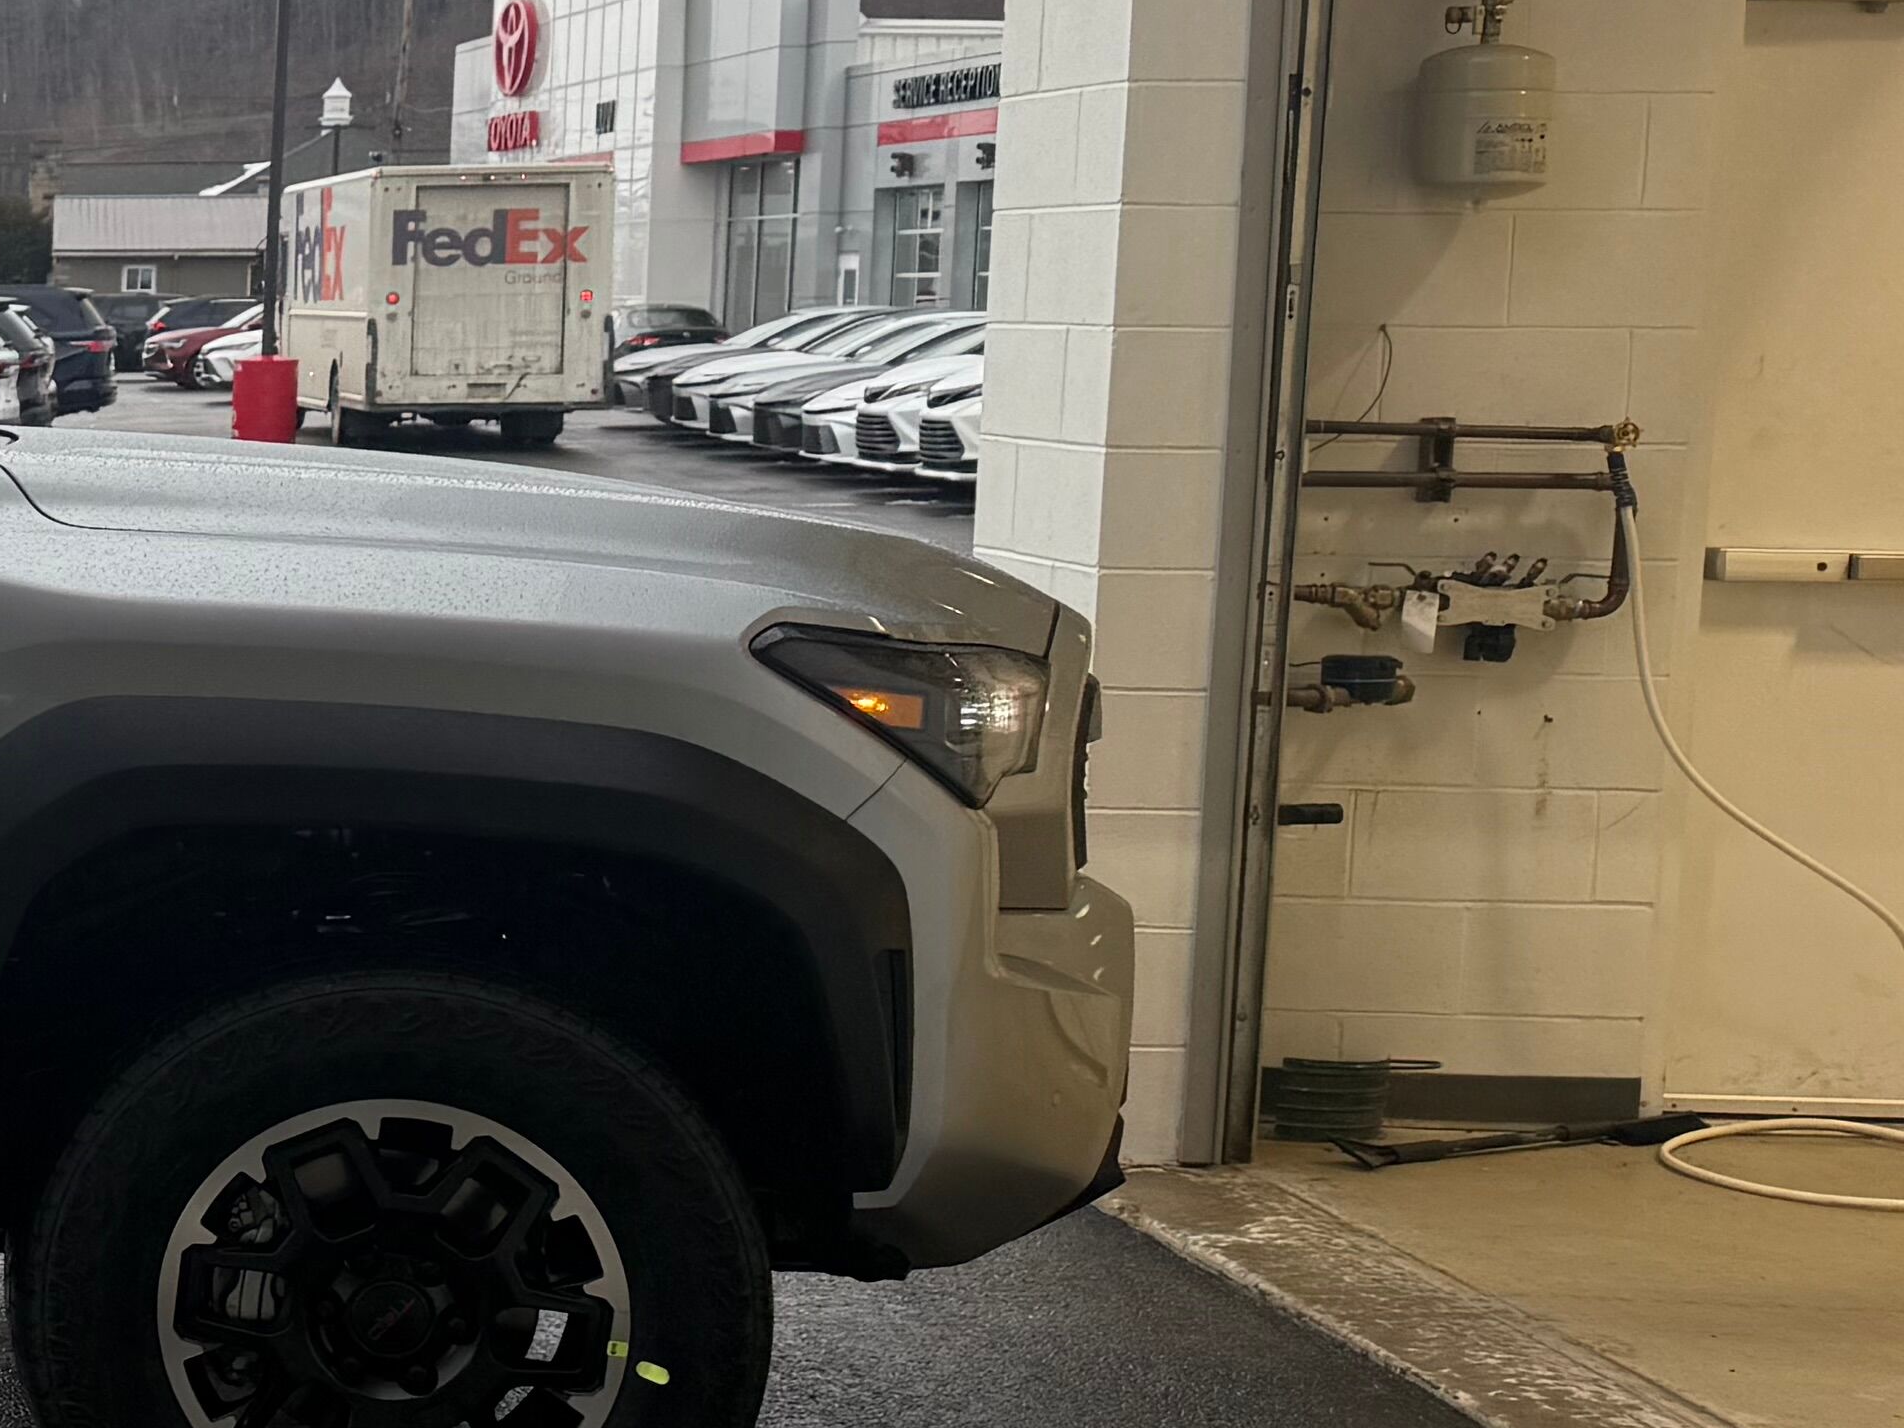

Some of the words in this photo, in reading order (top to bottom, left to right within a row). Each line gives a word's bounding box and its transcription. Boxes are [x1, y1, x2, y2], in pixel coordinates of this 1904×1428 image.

[488, 111, 531, 151] TOYOTA
[293, 187, 345, 303] FedEx
[392, 208, 590, 266] FedEx
[504, 270, 562, 284] Ground
